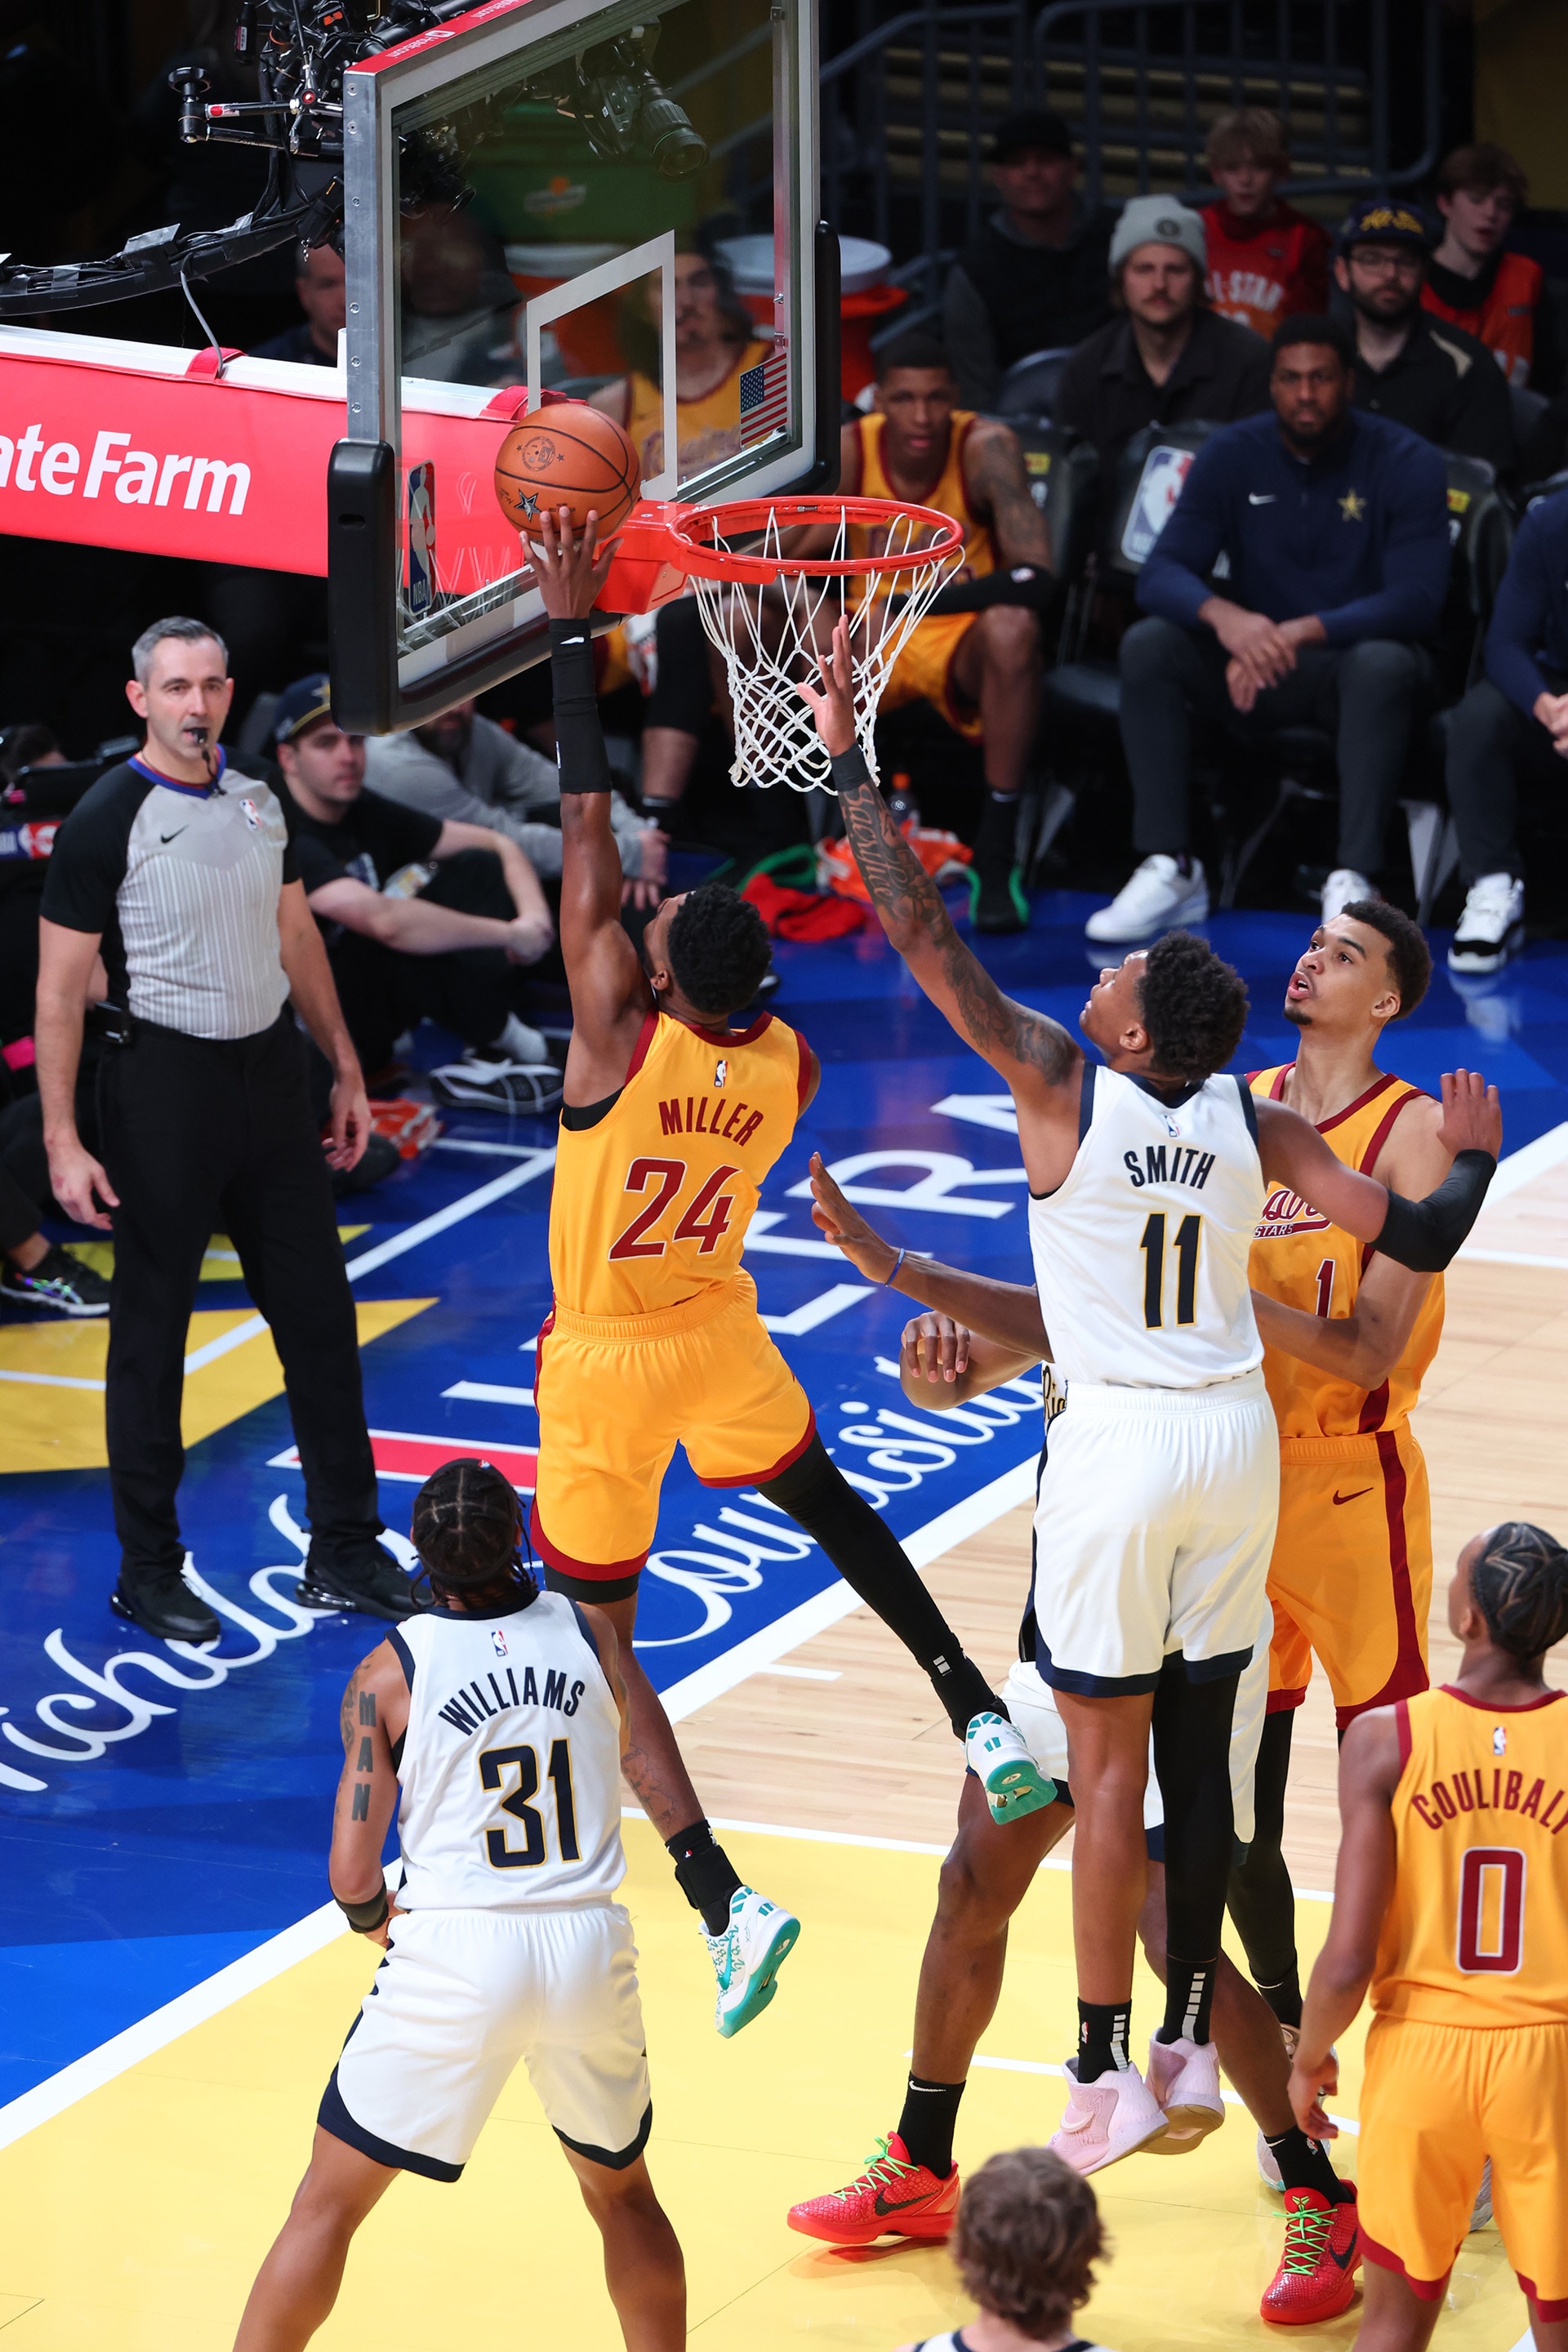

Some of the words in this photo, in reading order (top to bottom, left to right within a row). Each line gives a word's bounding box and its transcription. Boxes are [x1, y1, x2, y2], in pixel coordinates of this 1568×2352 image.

[412, 578, 426, 607] NBA
[658, 1097, 764, 1147] MILLER
[1123, 1145, 1217, 1190] SMITH
[608, 1156, 743, 1262] 24
[1254, 1223, 1294, 1237] STARS
[1139, 1211, 1203, 1330] 11
[1316, 1258, 1335, 1319] 1
[438, 1667, 586, 1736] WILLIAMS
[352, 1690, 376, 1821] MAN
[479, 1738, 582, 1870] 31
[1455, 1846, 1527, 1976] 0
